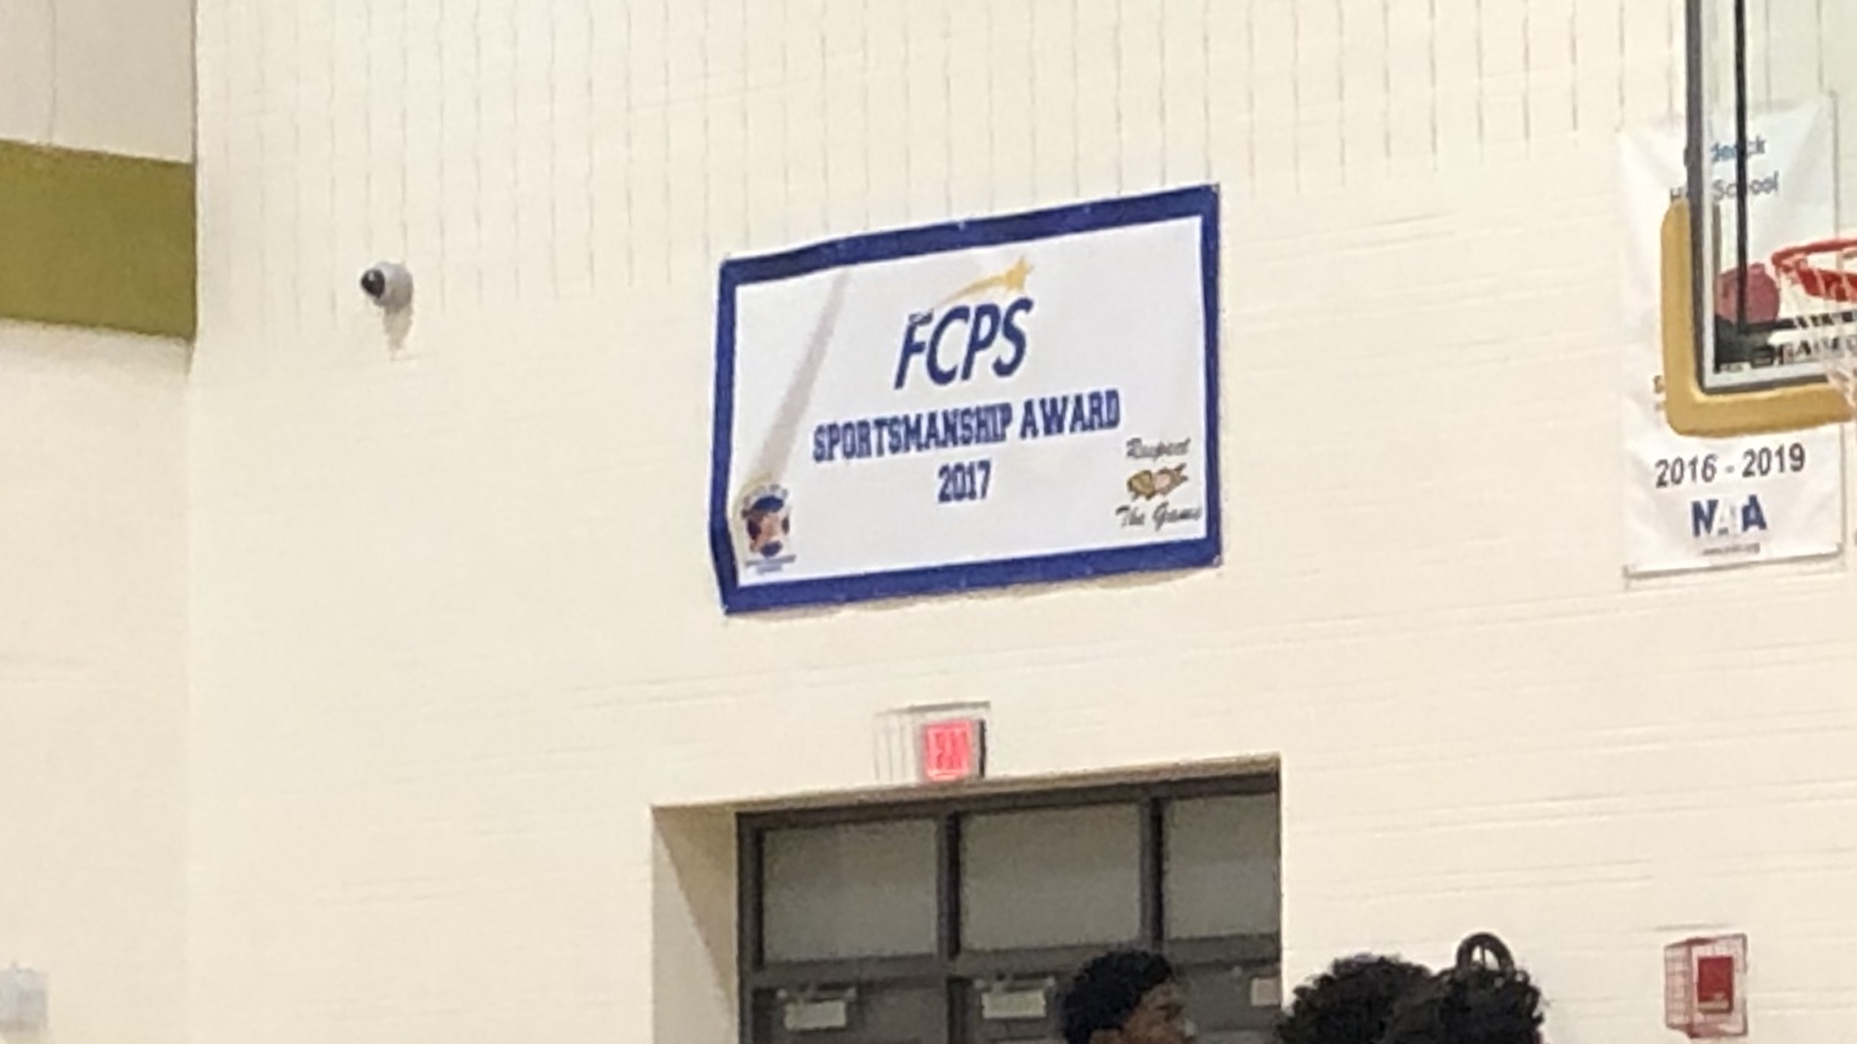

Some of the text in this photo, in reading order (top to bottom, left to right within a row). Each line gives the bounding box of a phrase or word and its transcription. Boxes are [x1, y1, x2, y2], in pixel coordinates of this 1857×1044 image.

[1712, 170, 1779, 200] Scool
[894, 297, 1034, 389] FCPS
[813, 388, 1120, 463] SPORTSMANSHIP AWARD
[938, 459, 992, 503] 2017
[1656, 454, 1719, 489] 2016
[1743, 442, 1806, 478] 2019
